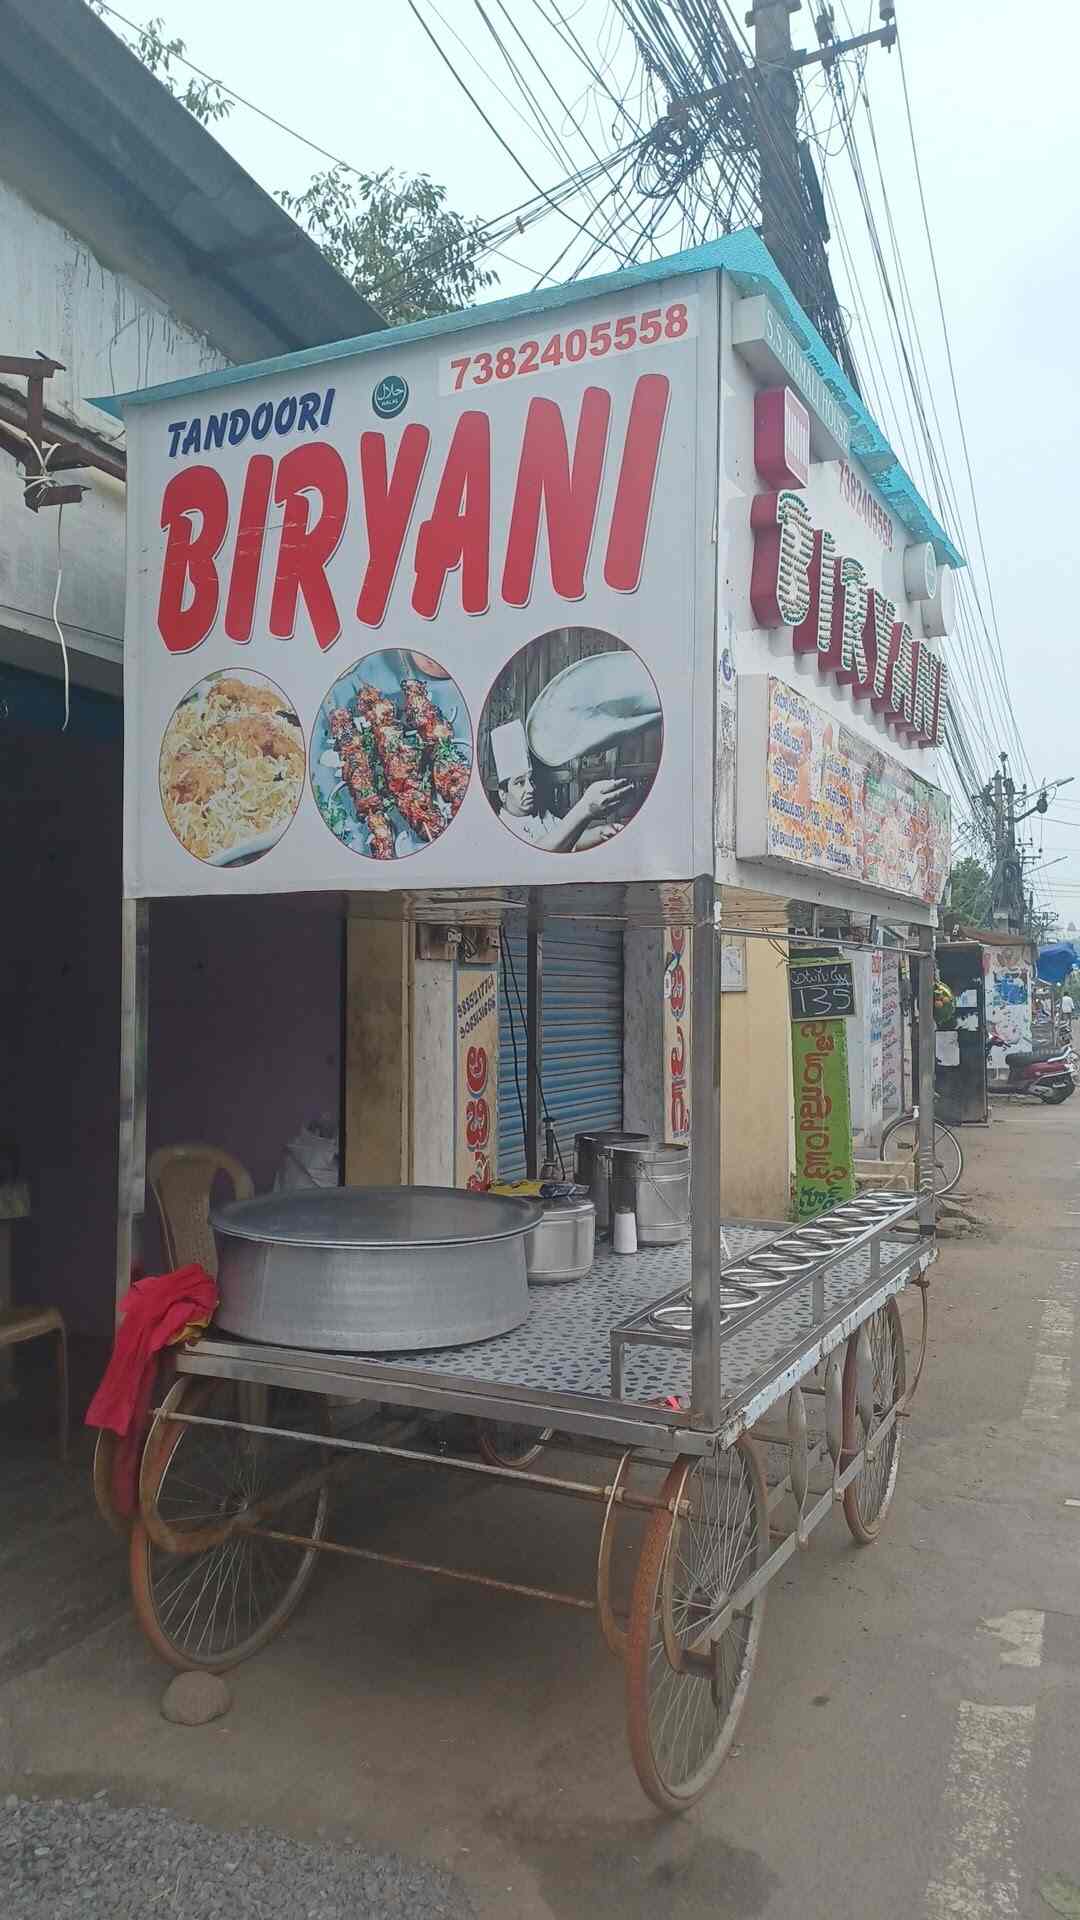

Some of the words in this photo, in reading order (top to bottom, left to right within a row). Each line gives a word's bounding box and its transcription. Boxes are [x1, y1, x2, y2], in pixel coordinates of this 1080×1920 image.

[450, 303, 690, 391] 7382405558
[167, 388, 336, 458] TANDOORI
[155, 373, 671, 654] BIRYANI
[776, 489, 951, 748] BIRYANI
[800, 986, 851, 1015] 135
